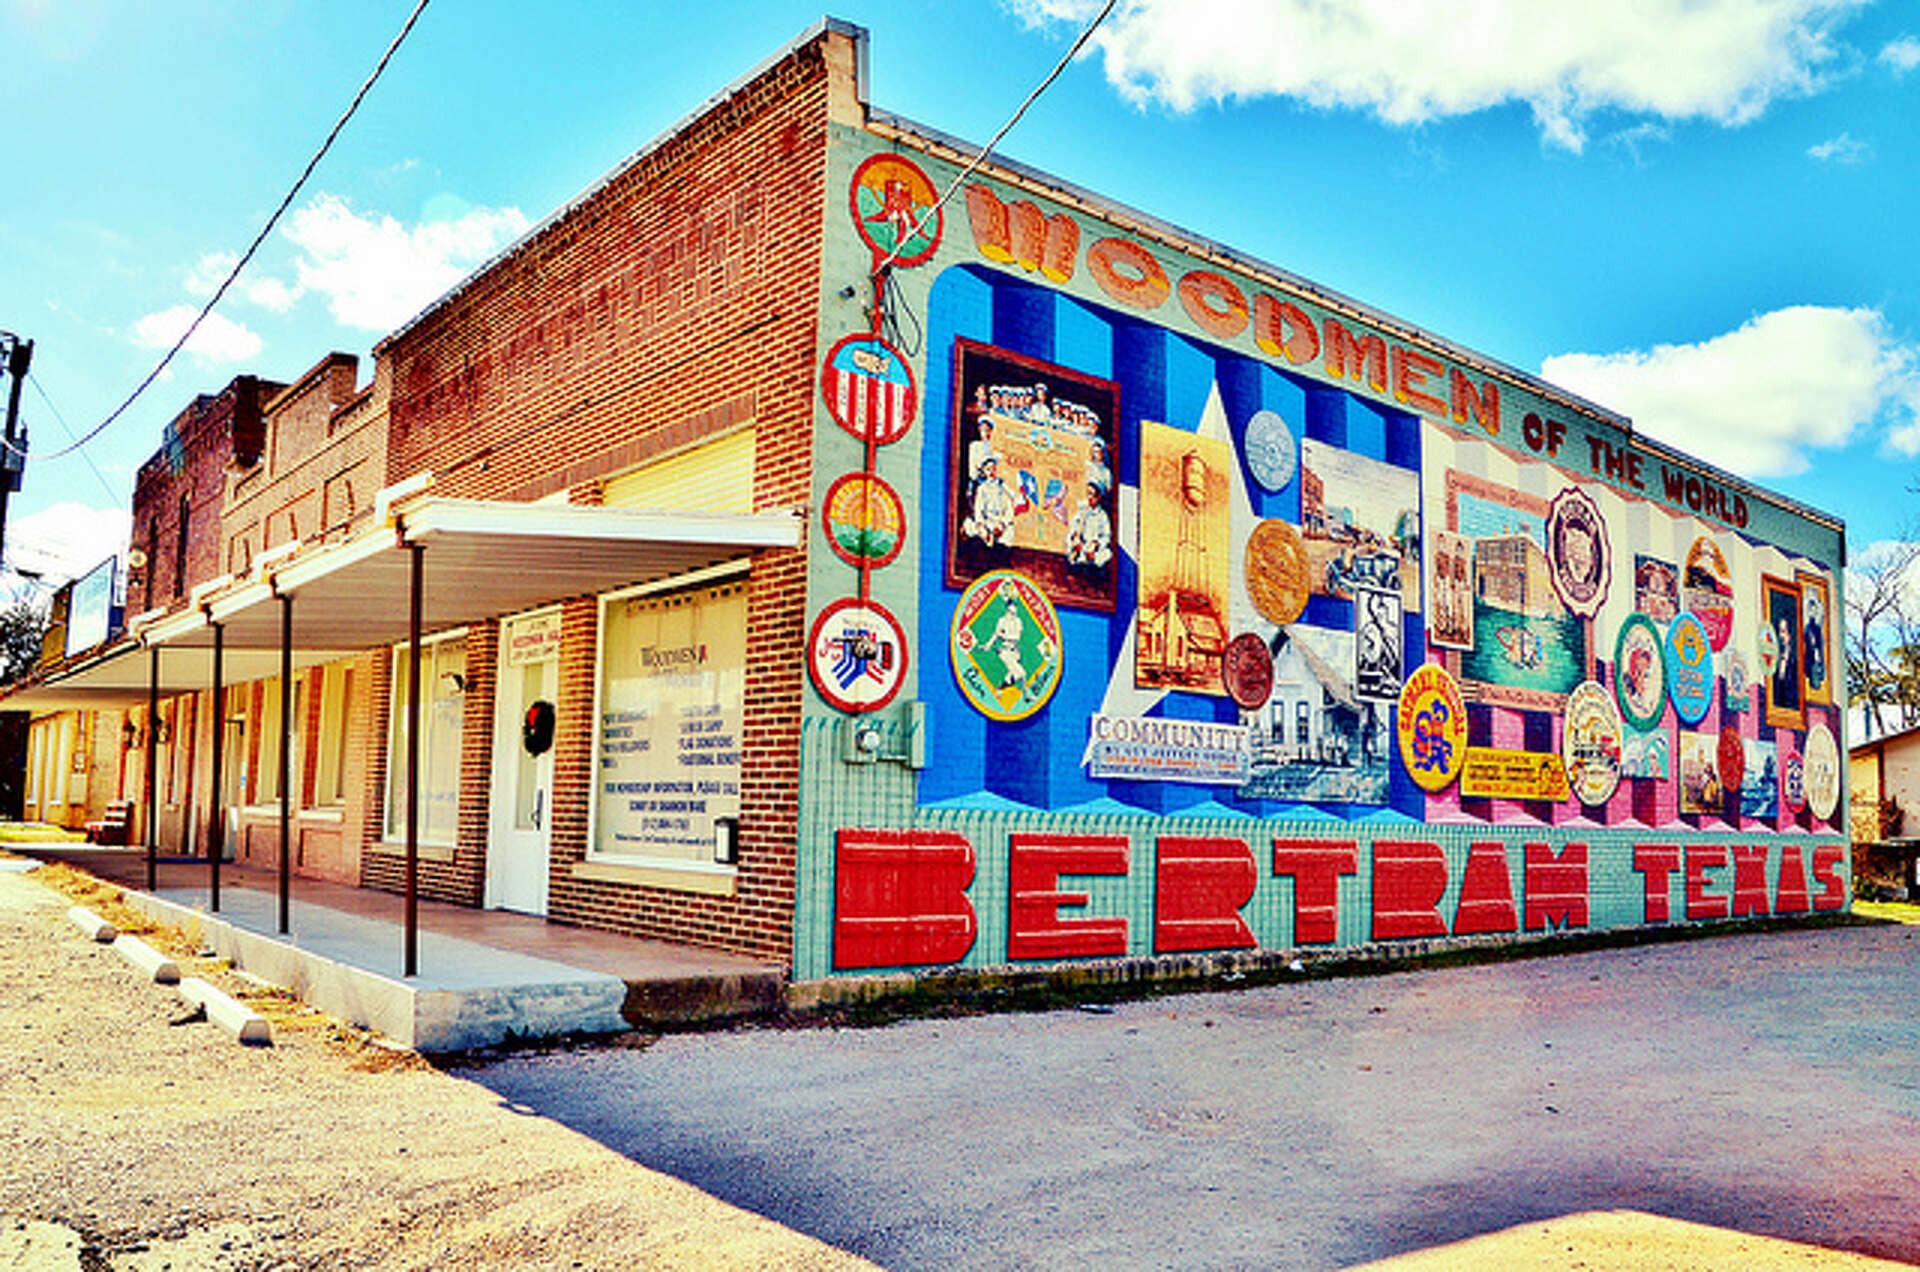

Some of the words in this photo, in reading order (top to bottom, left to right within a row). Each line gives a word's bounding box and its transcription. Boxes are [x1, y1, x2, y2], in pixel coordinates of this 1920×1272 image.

[964, 182, 1499, 435] WOODMEN
[1521, 411, 1567, 458] OF
[1586, 434, 1646, 490] THE
[1660, 464, 1749, 529] WORLD
[1095, 716, 1247, 752] COMMUNITY
[832, 828, 1588, 970] BERTRAM
[1633, 843, 1846, 922] TEXAS
